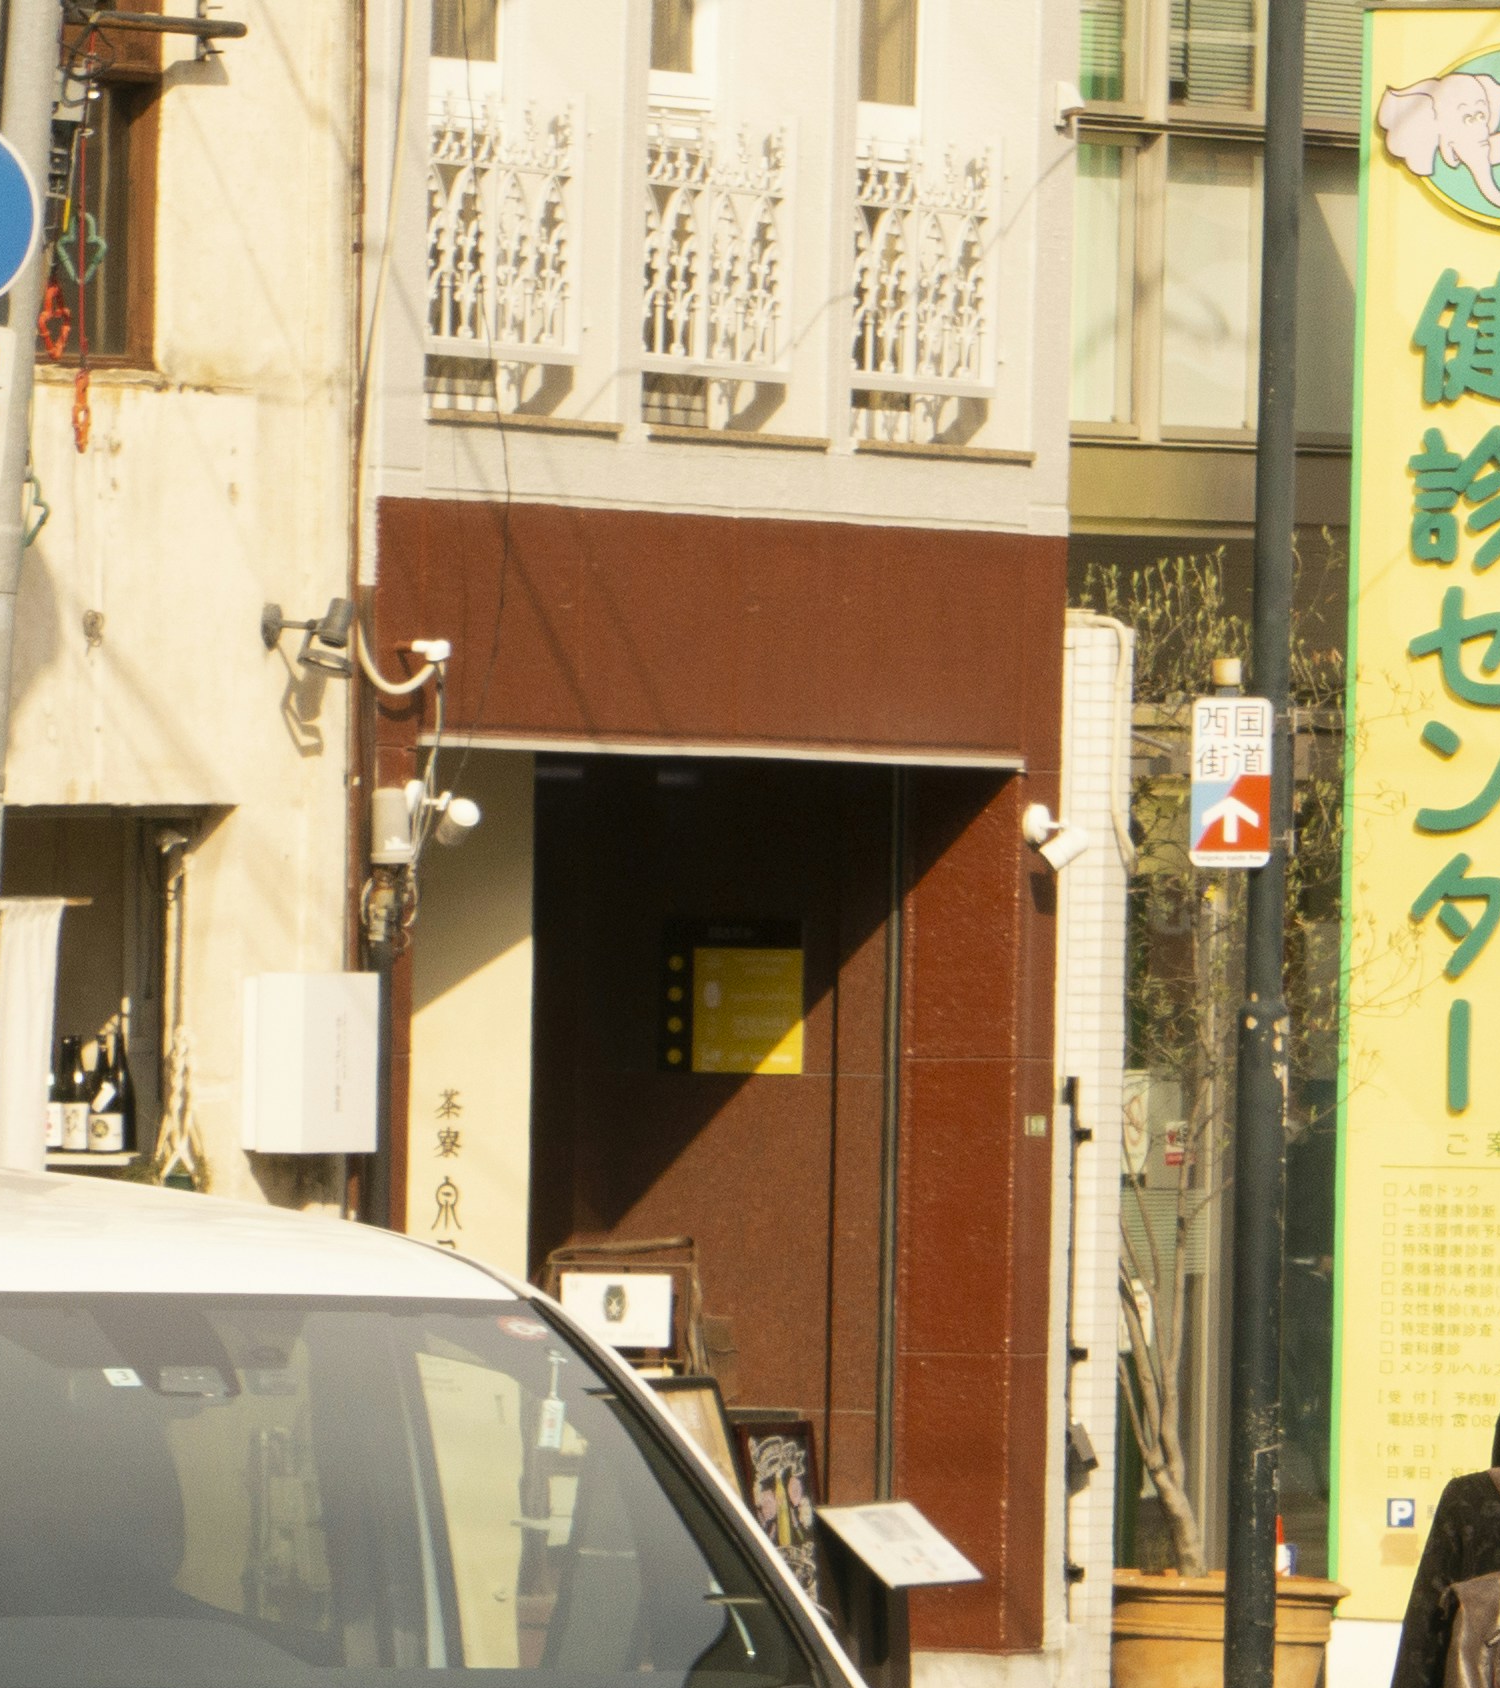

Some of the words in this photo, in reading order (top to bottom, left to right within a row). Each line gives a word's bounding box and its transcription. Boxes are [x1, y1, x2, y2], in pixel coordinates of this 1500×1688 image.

[1197, 706, 1265, 737] 西国
[1195, 743, 1263, 777] 街道
[433, 1088, 463, 1159] 茶寮
[1402, 1183, 1480, 1198] 人間ドック
[1401, 1203, 1496, 1218] 一般健康診断
[1390, 1500, 1413, 1526] P
